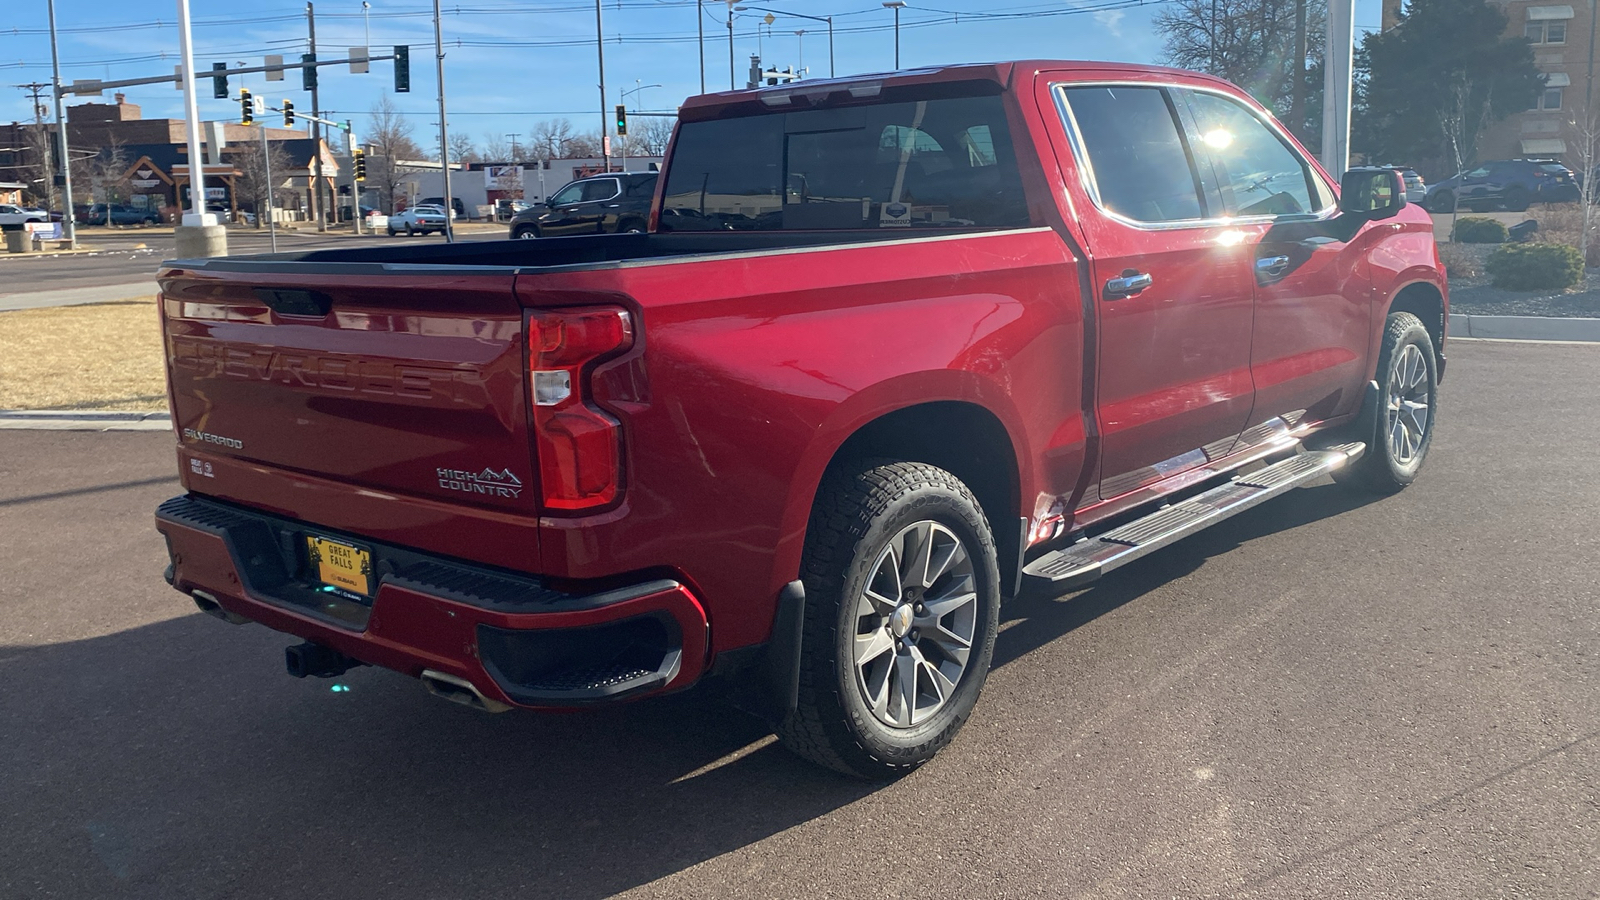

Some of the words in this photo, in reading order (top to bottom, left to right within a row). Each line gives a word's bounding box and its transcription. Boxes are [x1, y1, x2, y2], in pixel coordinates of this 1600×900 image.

[184, 427, 244, 449] SILVERADO
[436, 467, 478, 481] HIGH
[439, 479, 522, 498] COUNTRY
[328, 545, 351, 559] GREAT
[330, 555, 353, 570] FALLS
